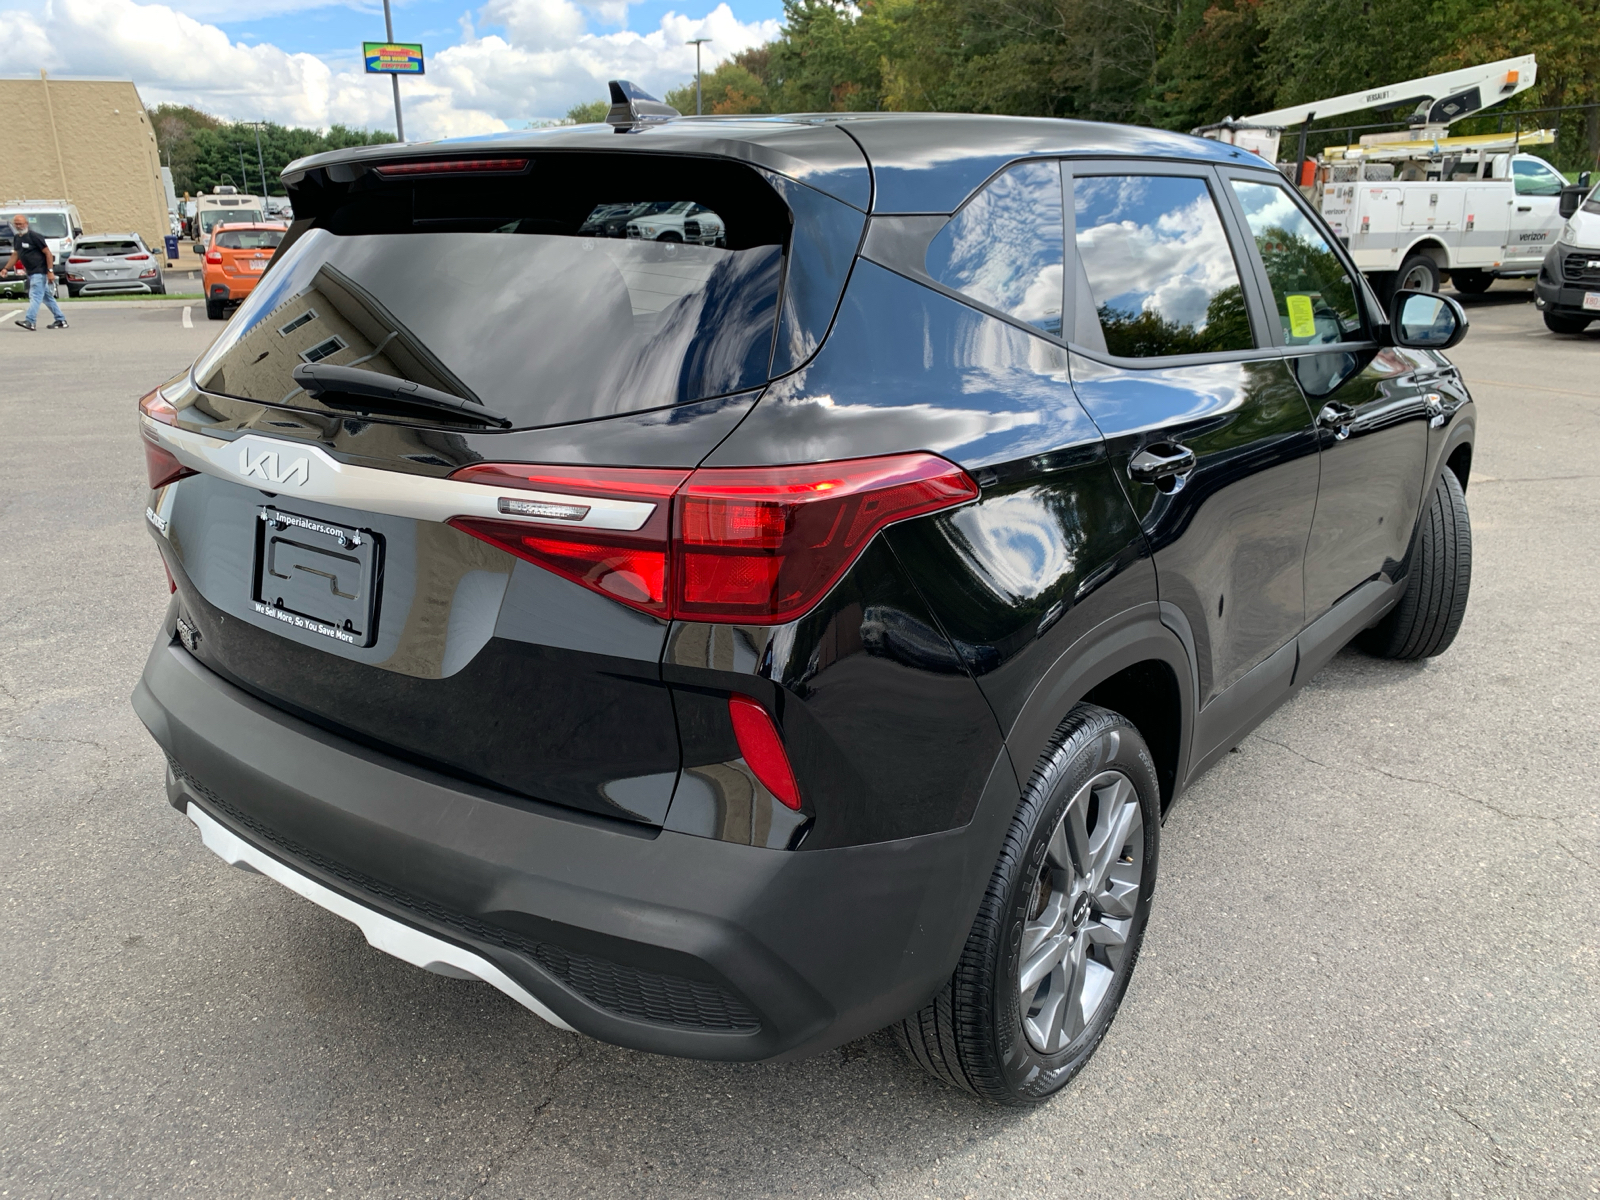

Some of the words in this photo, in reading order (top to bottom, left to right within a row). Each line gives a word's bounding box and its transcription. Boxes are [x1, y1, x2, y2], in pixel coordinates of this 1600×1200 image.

[1366, 90, 1389, 103] VERSALIFT
[1519, 230, 1546, 241] verizon
[240, 447, 309, 486] KIA
[276, 512, 344, 537] Imperialcars.com
[255, 603, 264, 614] We
[265, 607, 276, 618] Sell
[277, 610, 294, 626] More,
[294, 617, 304, 627] So
[305, 620, 317, 631] You
[318, 625, 334, 637] Save
[336, 630, 353, 643] More
[1007, 838, 1046, 979] SOLUS
